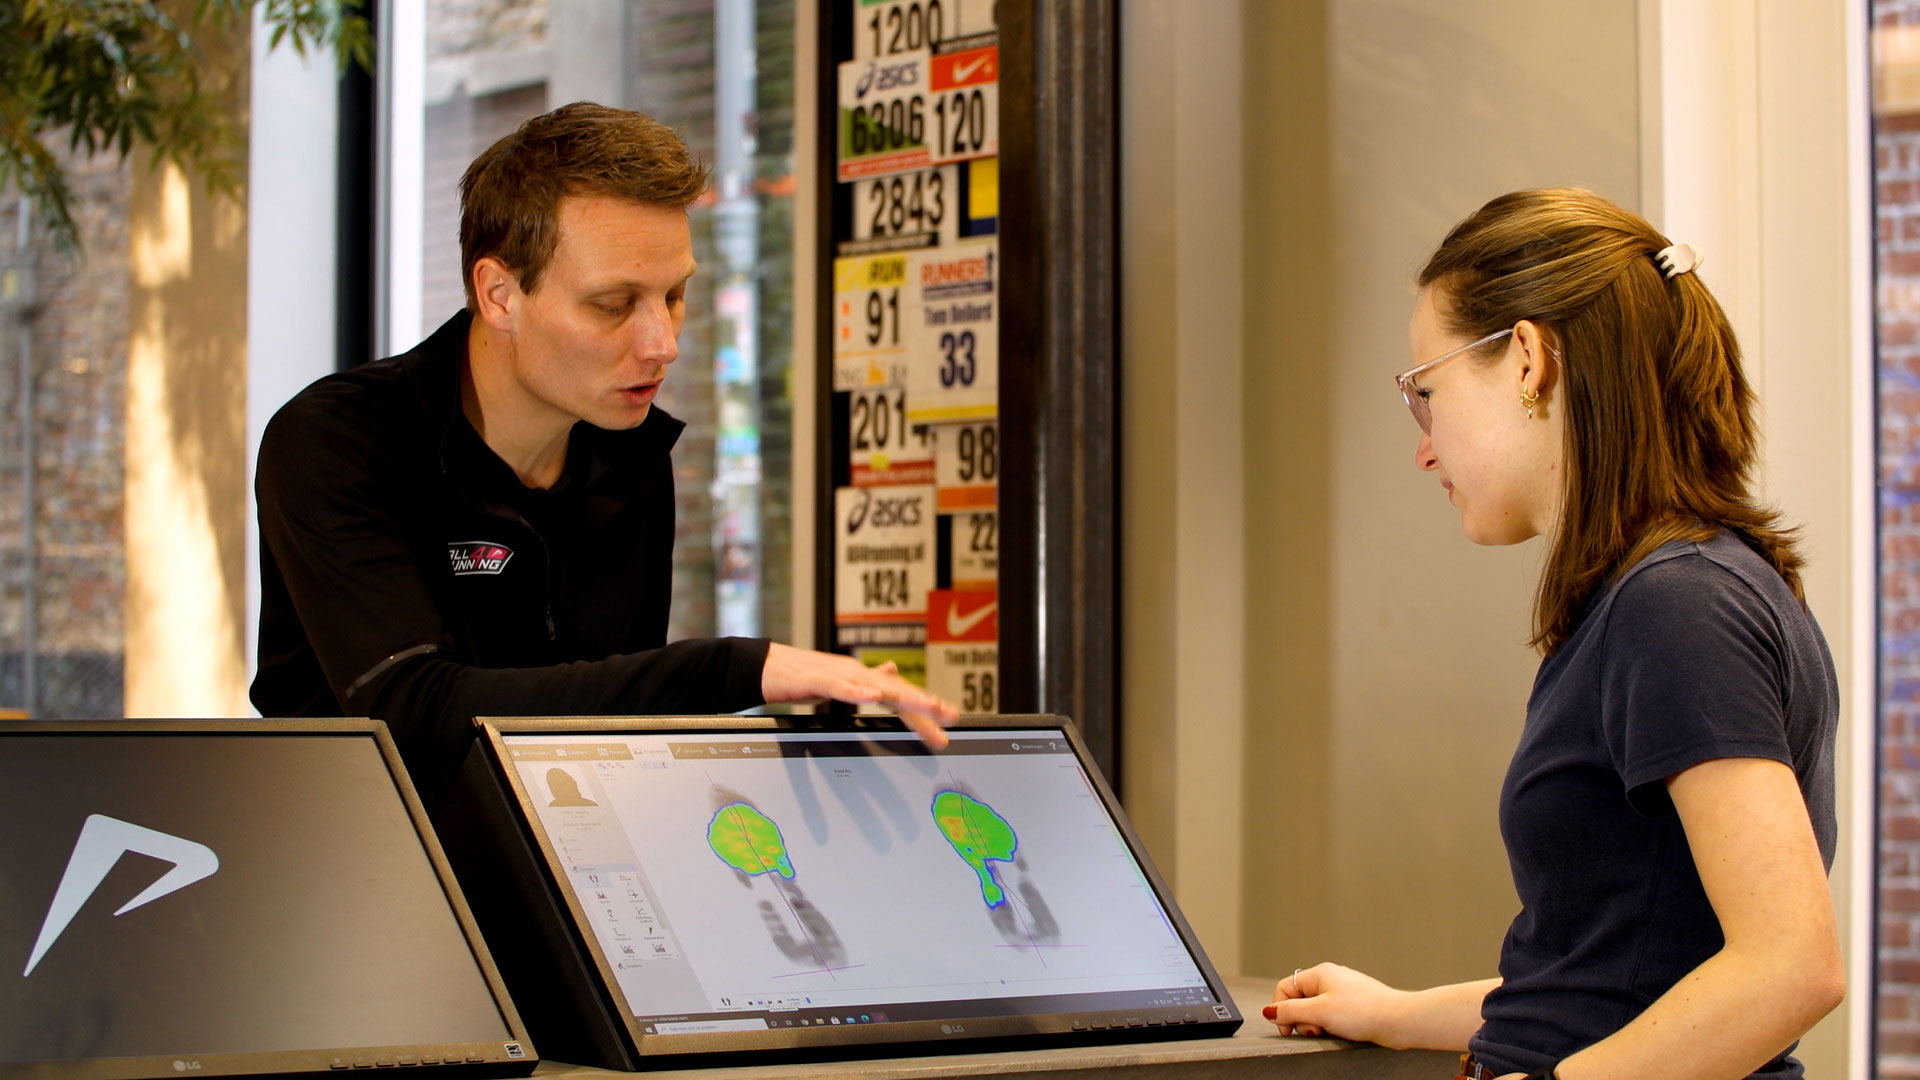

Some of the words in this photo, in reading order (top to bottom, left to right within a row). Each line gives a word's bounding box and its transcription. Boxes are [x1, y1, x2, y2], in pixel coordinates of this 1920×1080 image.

[869, 0, 943, 57] 1200
[853, 95, 924, 154] 6306
[935, 89, 985, 156] 120
[870, 170, 944, 237] 2843
[866, 288, 900, 347] 91
[939, 331, 976, 387] 33
[958, 424, 996, 481] 98
[862, 568, 909, 608] 1424
[963, 672, 995, 712] 58
[951, 1024, 965, 1034] LG
[186, 1060, 201, 1070] LG
